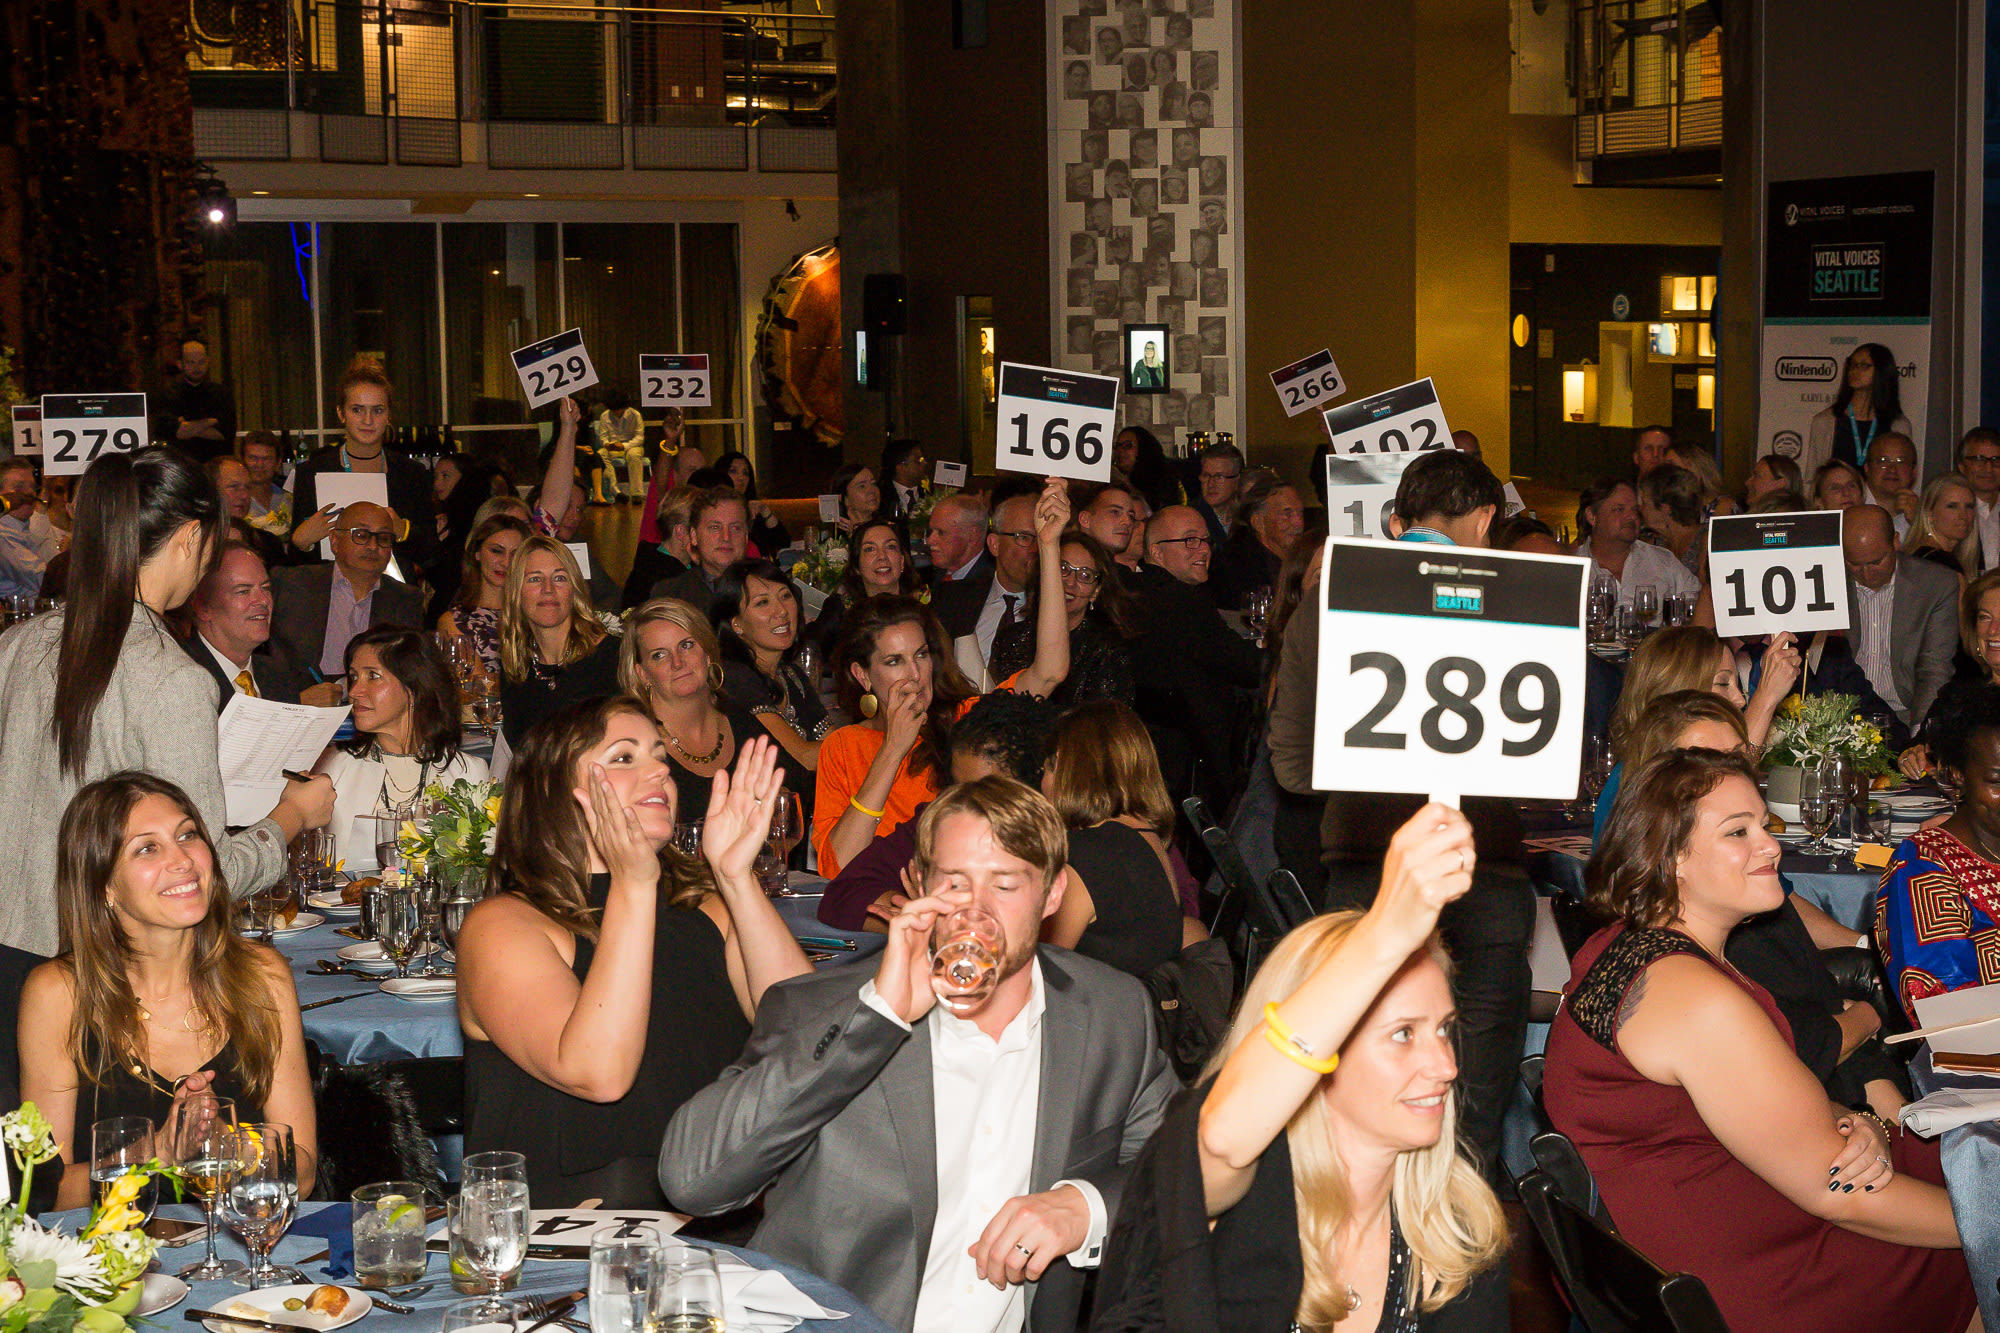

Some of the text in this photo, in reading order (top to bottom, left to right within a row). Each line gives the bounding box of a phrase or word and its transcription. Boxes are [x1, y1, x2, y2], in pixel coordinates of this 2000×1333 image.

[1815, 249, 1880, 267] VITAL VOICES
[1814, 269, 1880, 293] SEATTLE
[527, 355, 586, 397] 229
[1780, 363, 1832, 376] Nintendo
[647, 377, 705, 399] 232
[1284, 371, 1338, 408] 266
[53, 428, 140, 462] 279
[1010, 413, 1103, 465] 166
[1764, 536, 1786, 544] SEATTLE
[1725, 564, 1835, 616] 101
[1436, 595, 1481, 611] SEATTLE
[1344, 651, 1561, 757] 289
[531, 1215, 661, 1239] 14
